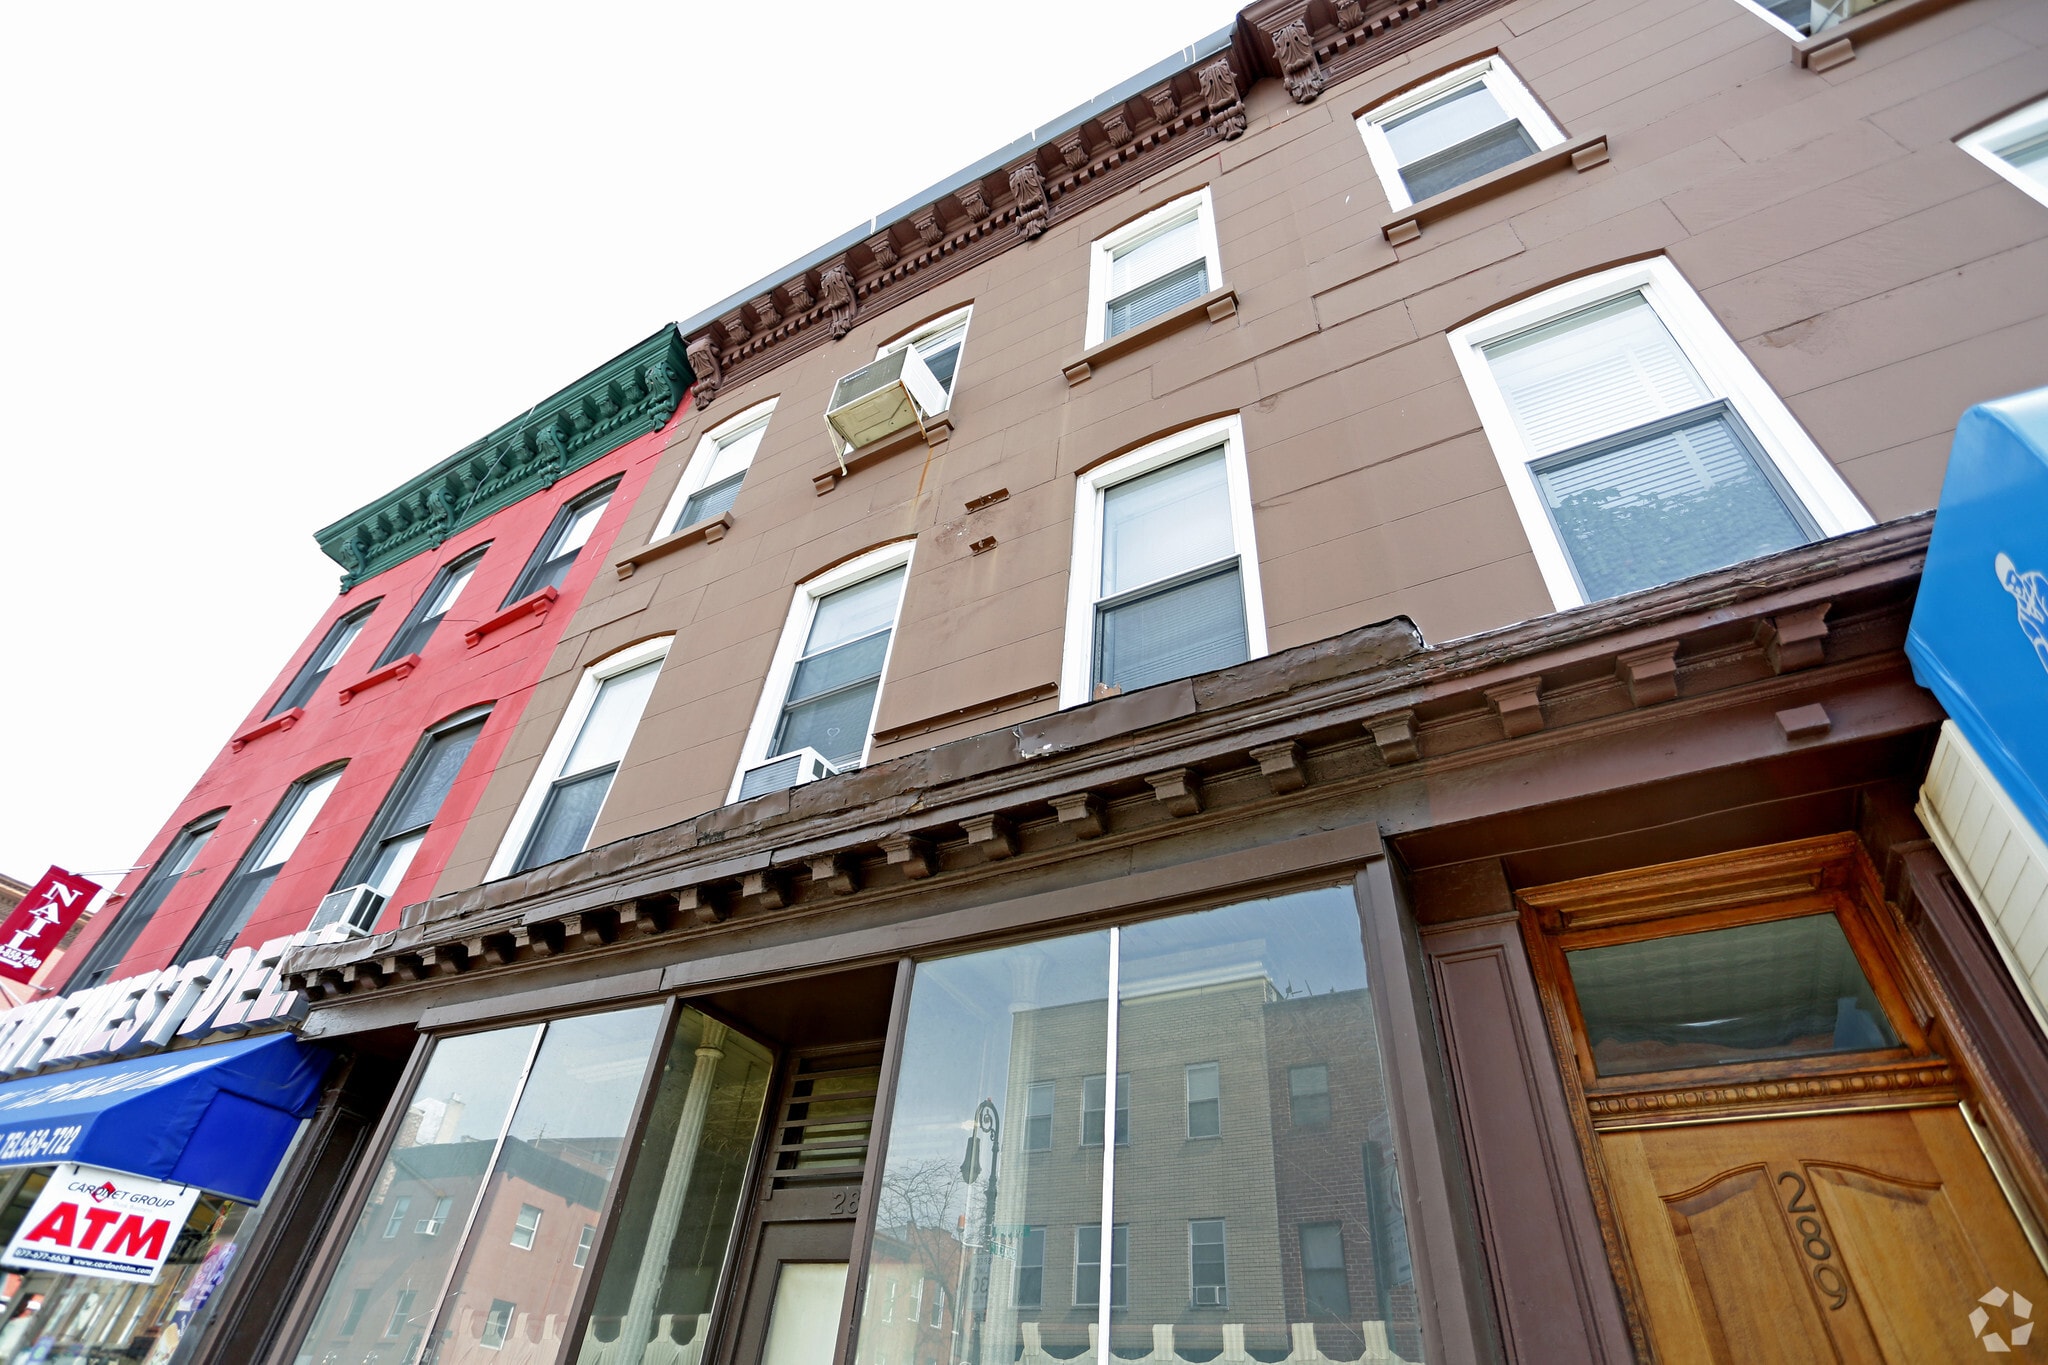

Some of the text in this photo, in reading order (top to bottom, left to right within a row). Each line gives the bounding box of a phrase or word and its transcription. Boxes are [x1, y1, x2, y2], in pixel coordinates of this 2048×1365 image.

[3, 880, 84, 956] NAIL
[13, 954, 218, 1068] FINEST
[23, 1201, 171, 1261] ATM
[67, 1181, 131, 1200] CARDNET
[129, 1193, 175, 1208] GROUP
[1777, 1171, 1848, 1311] 289
